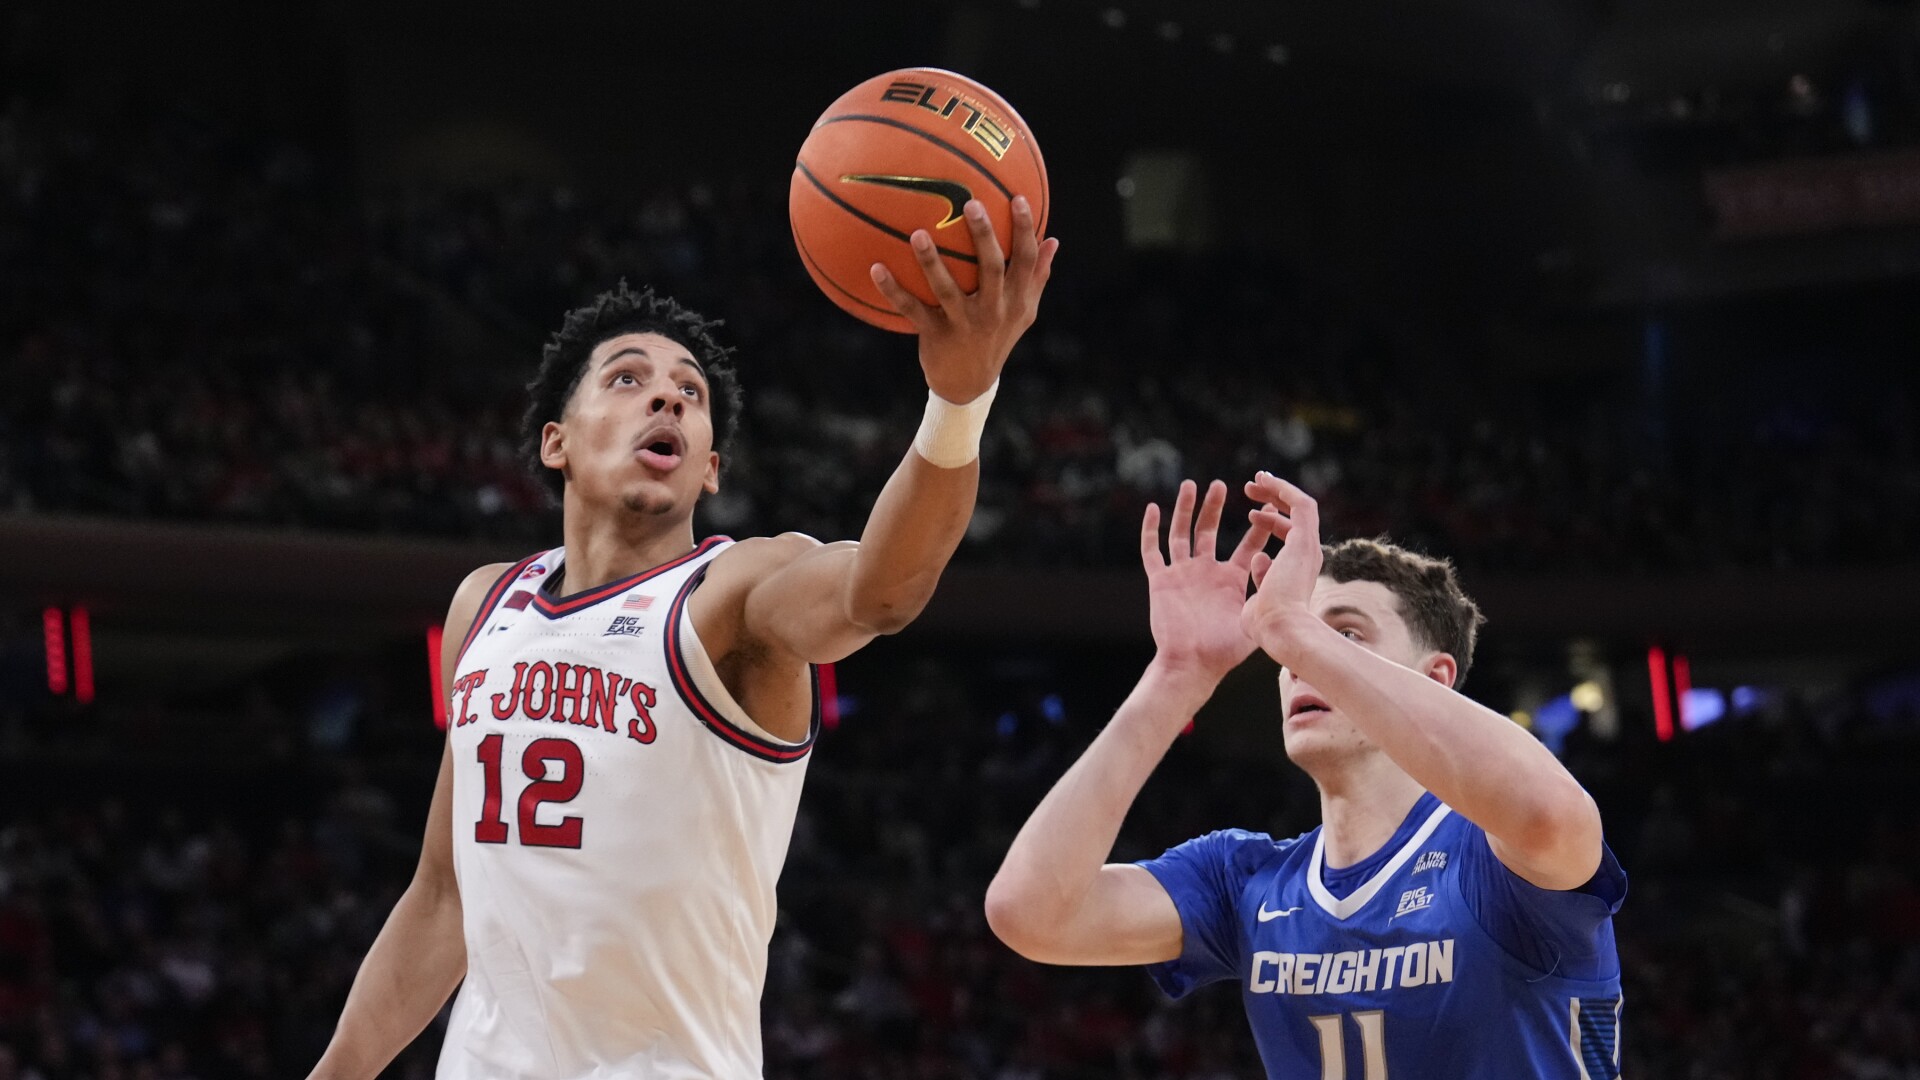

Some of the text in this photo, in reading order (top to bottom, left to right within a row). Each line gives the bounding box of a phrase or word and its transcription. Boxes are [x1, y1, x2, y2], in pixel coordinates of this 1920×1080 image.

[881, 82, 1014, 161] ELITE
[606, 624, 645, 635] EAST
[612, 616, 640, 625] BIG
[448, 660, 657, 744] T. JOHN'S
[475, 734, 584, 849] 12
[1427, 851, 1448, 861] THE
[1396, 893, 1435, 913] EAST
[1401, 886, 1428, 903] BIG
[1250, 939, 1455, 995] CREIGHTON
[1308, 1009, 1389, 1080] 11
